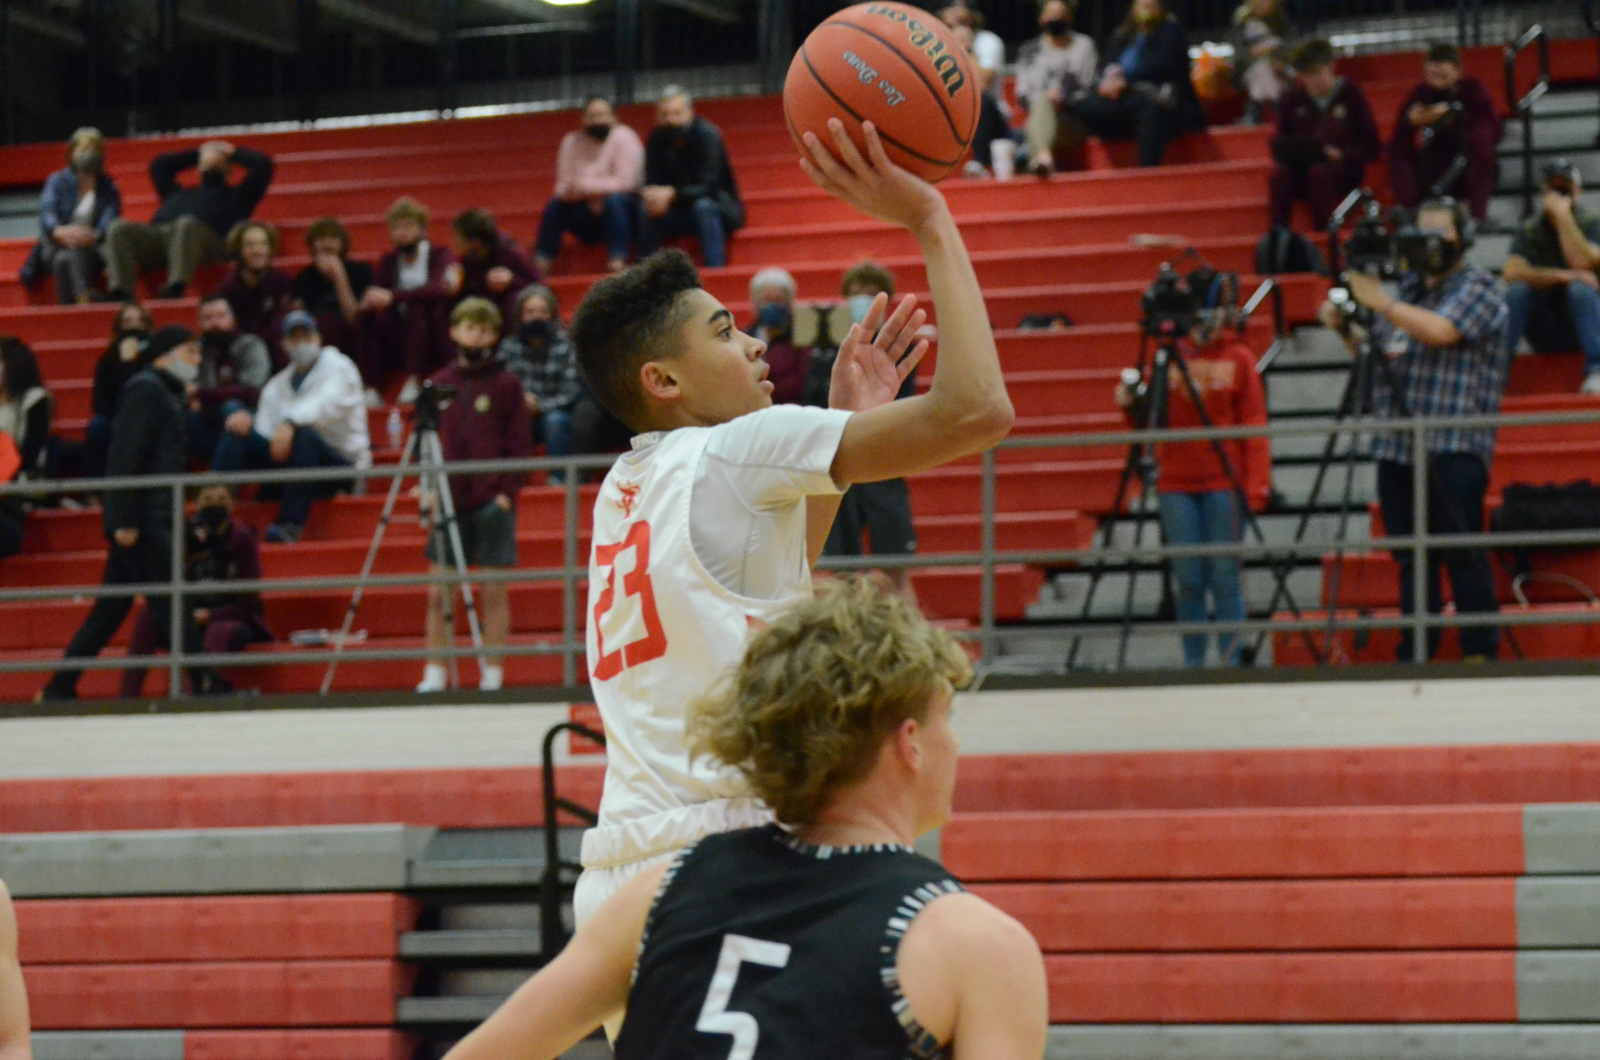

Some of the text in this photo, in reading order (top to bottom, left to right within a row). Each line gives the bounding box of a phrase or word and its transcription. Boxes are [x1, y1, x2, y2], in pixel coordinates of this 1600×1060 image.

[842, 50, 906, 106] Los Dons
[866, 6, 965, 98] Wilson
[593, 519, 667, 681] 23
[695, 933, 791, 1060] 5
